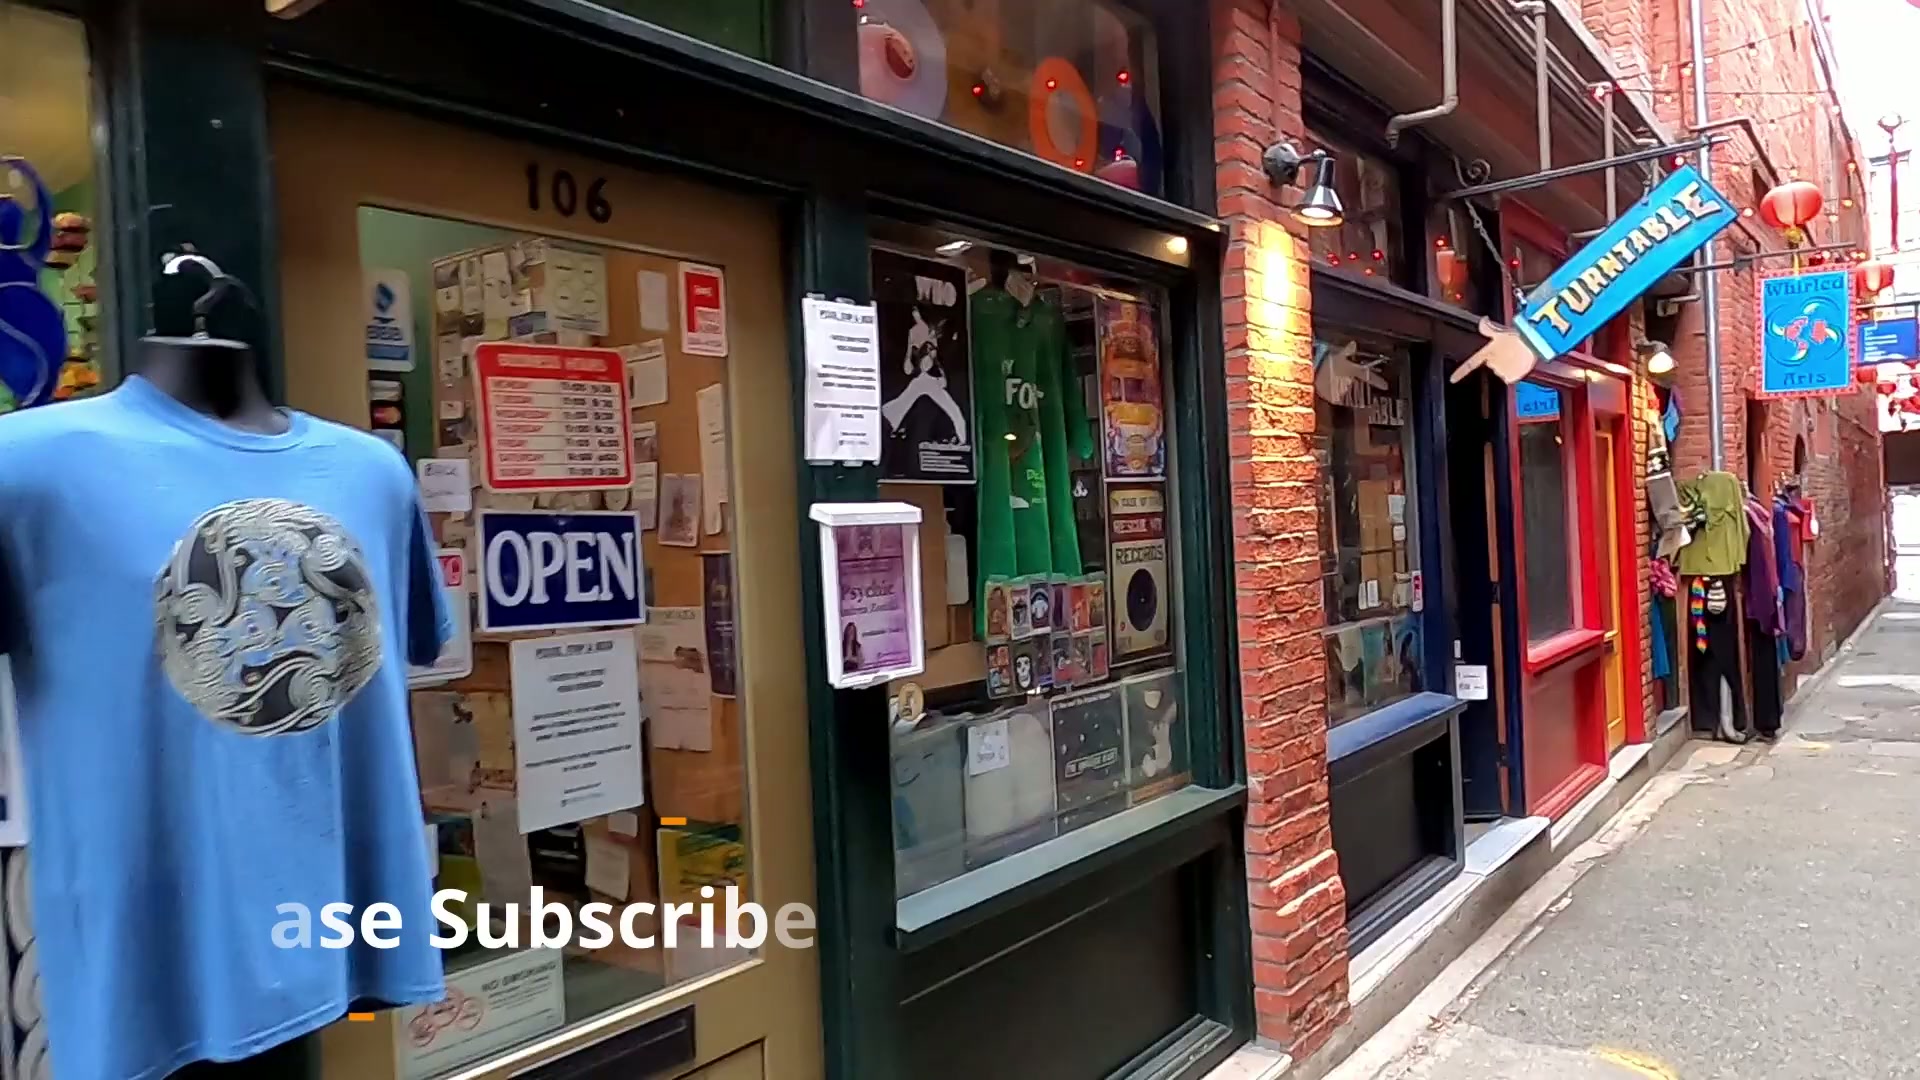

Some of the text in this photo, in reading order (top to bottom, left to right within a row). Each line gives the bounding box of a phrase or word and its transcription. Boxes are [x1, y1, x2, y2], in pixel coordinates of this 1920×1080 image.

[524, 164, 613, 224] 106
[1529, 181, 1721, 338] TURNTABLE
[1766, 276, 1844, 297] Whirled
[1783, 371, 1827, 386] Arts
[487, 530, 636, 607] OPEN
[1115, 544, 1164, 565] RECORDS
